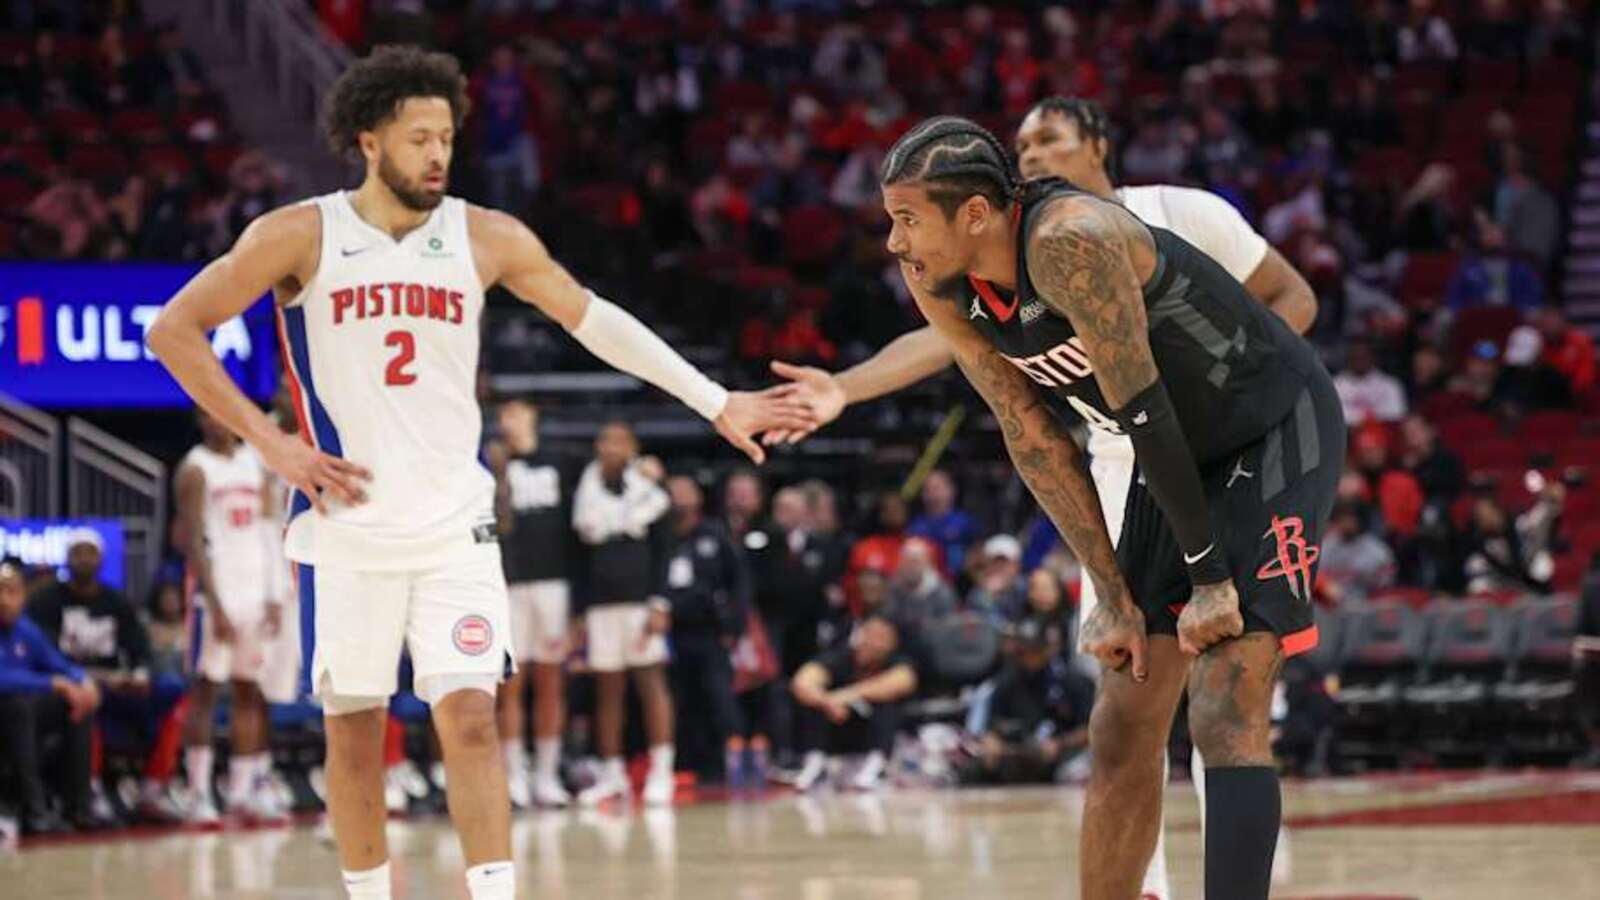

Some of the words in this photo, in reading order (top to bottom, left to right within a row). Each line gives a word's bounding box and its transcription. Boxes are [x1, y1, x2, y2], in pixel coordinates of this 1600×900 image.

[331, 283, 464, 324] PISTONS
[56, 304, 252, 361] ULTA
[385, 330, 418, 386] 2
[1067, 396, 1123, 435] 4
